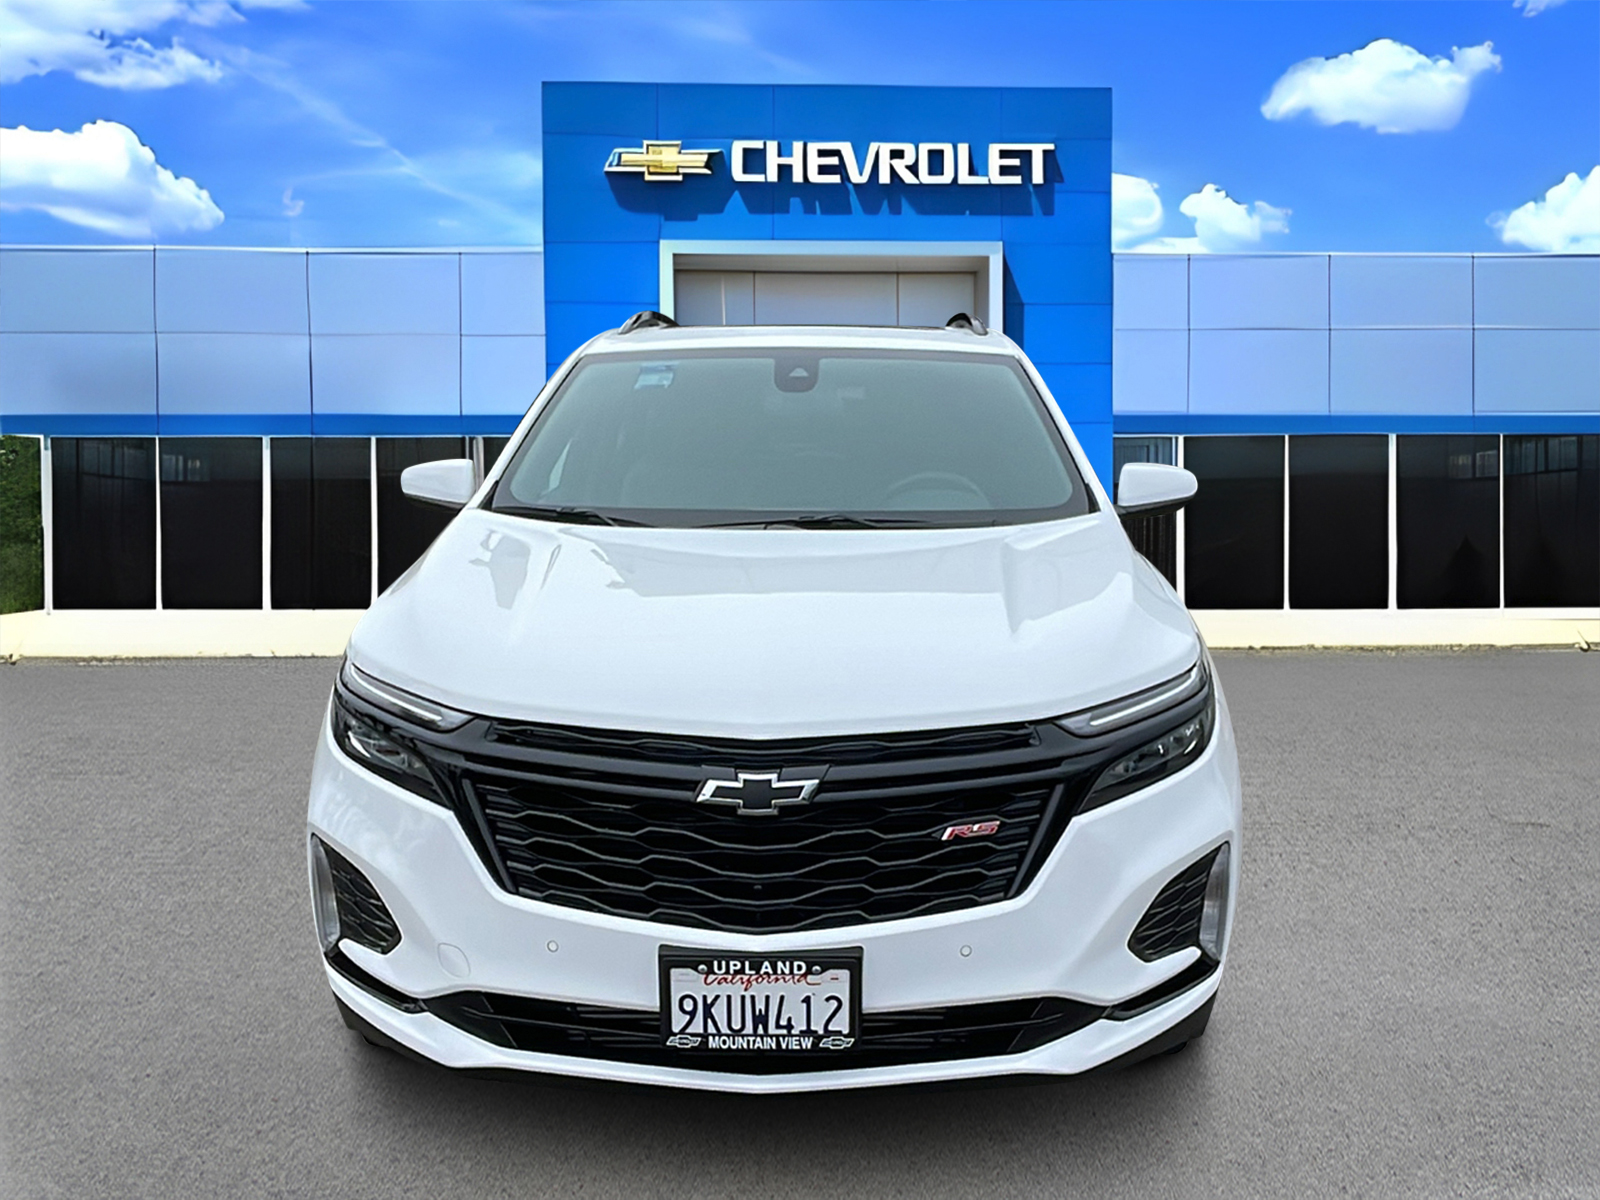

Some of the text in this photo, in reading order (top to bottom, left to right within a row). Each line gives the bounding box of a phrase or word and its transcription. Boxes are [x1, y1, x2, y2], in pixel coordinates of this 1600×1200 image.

[731, 140, 1055, 185] CHEVROLET
[941, 820, 1000, 841] RS
[713, 960, 807, 975] UPLAND
[678, 994, 843, 1034] 9KUW412
[708, 1036, 776, 1049] MOUNTAIN
[779, 1037, 813, 1049] VIEW
